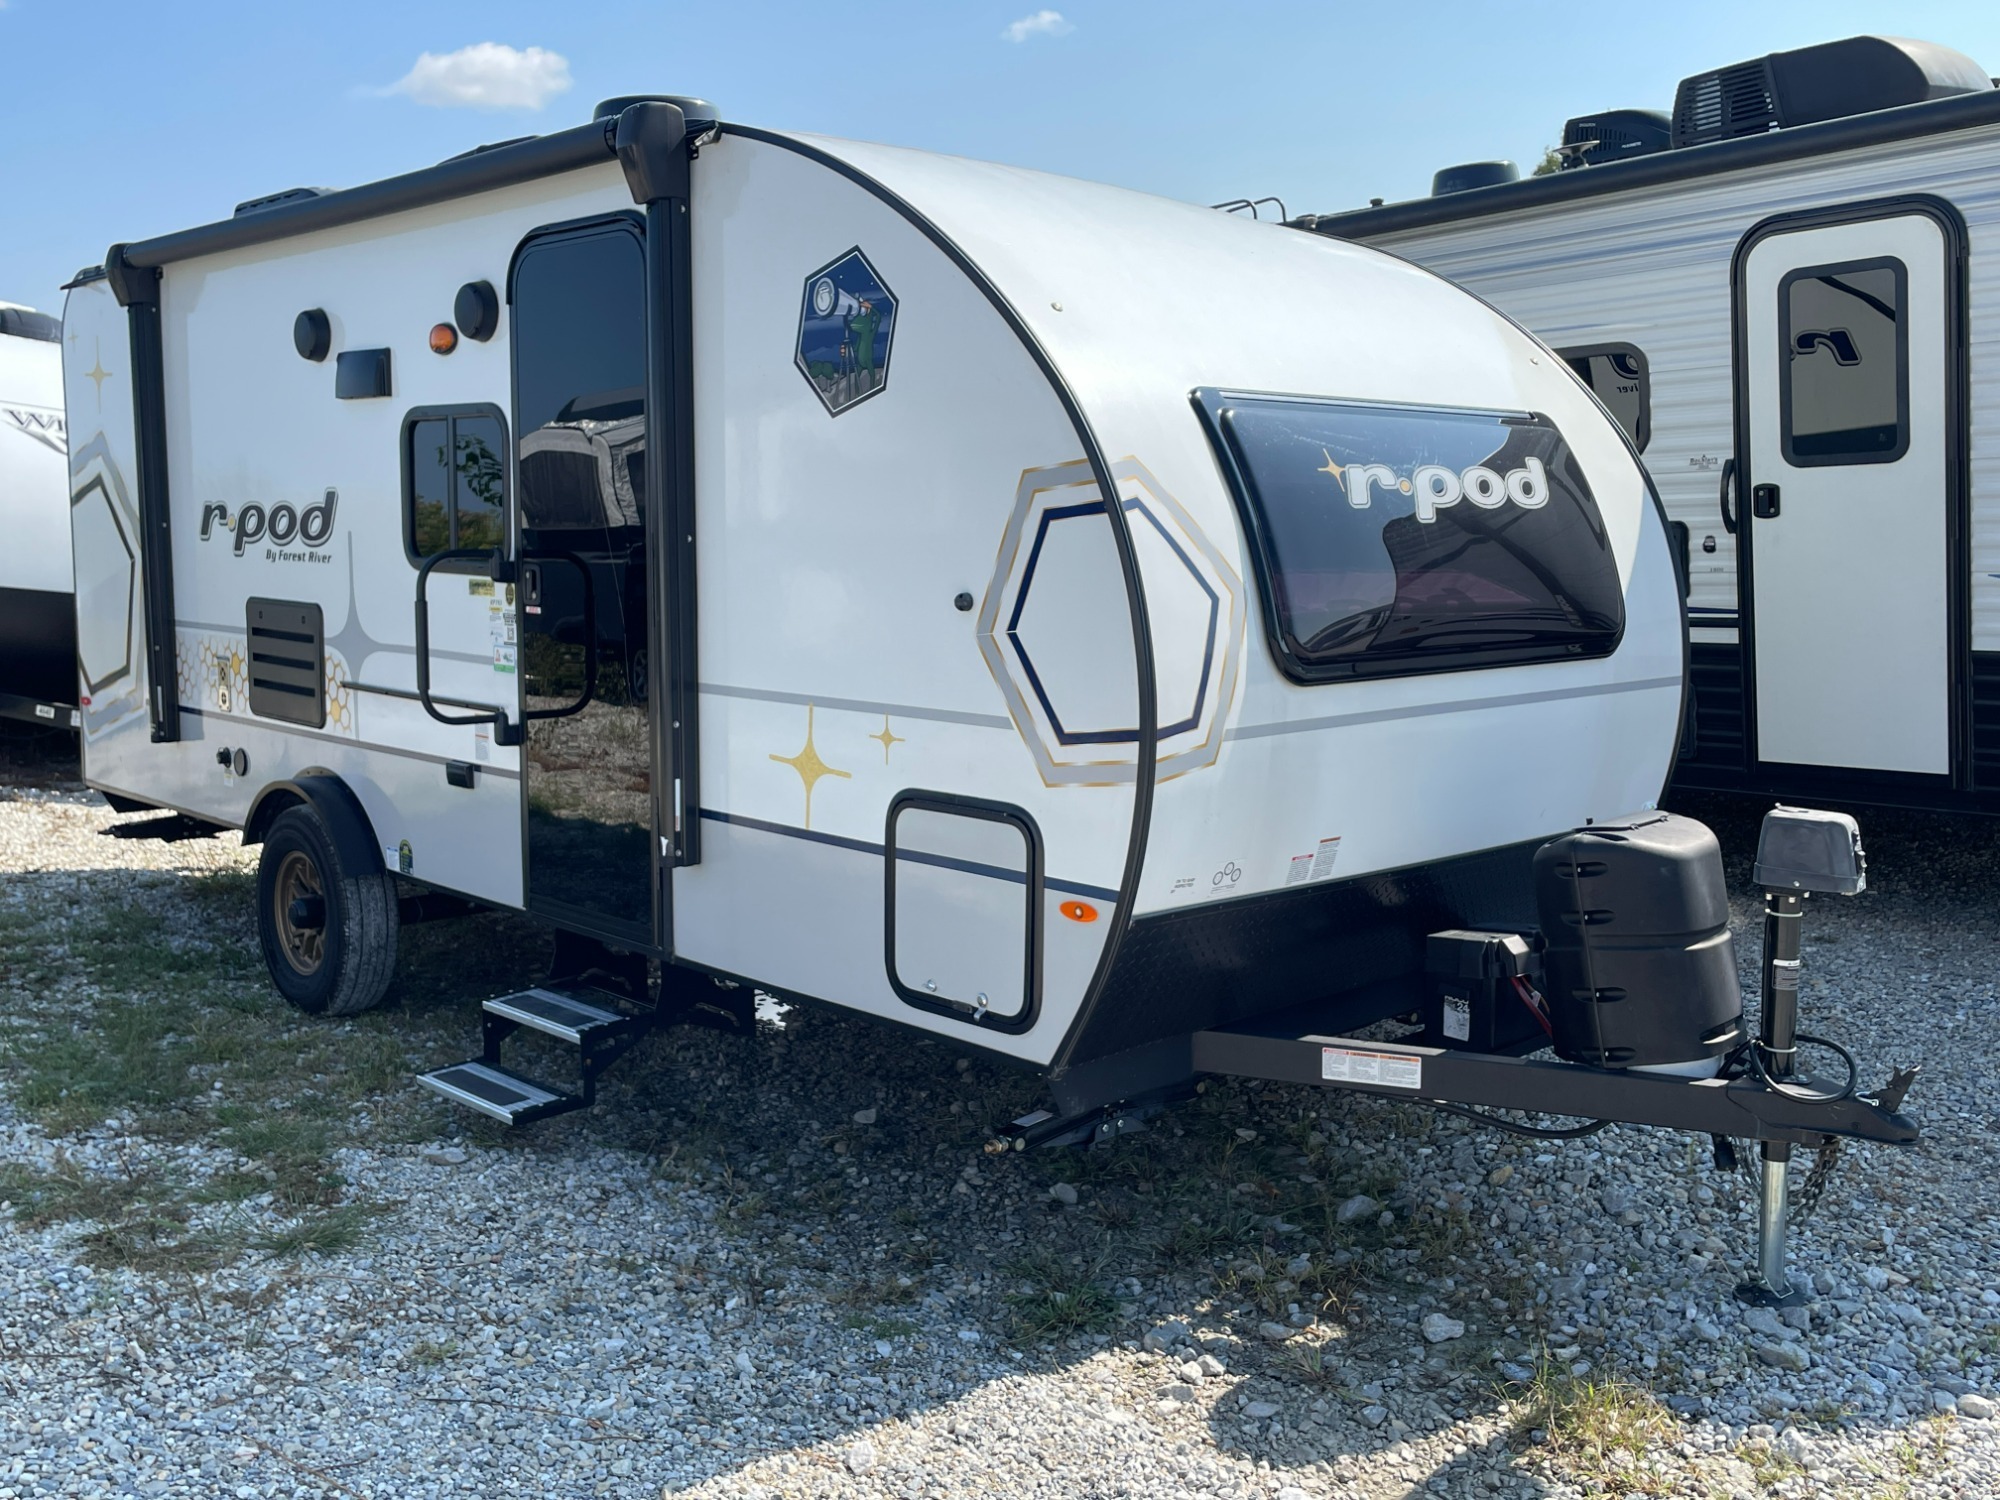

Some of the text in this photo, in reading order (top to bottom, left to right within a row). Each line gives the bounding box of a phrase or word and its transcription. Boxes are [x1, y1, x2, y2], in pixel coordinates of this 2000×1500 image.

[265, 549, 332, 564] By Forest River
